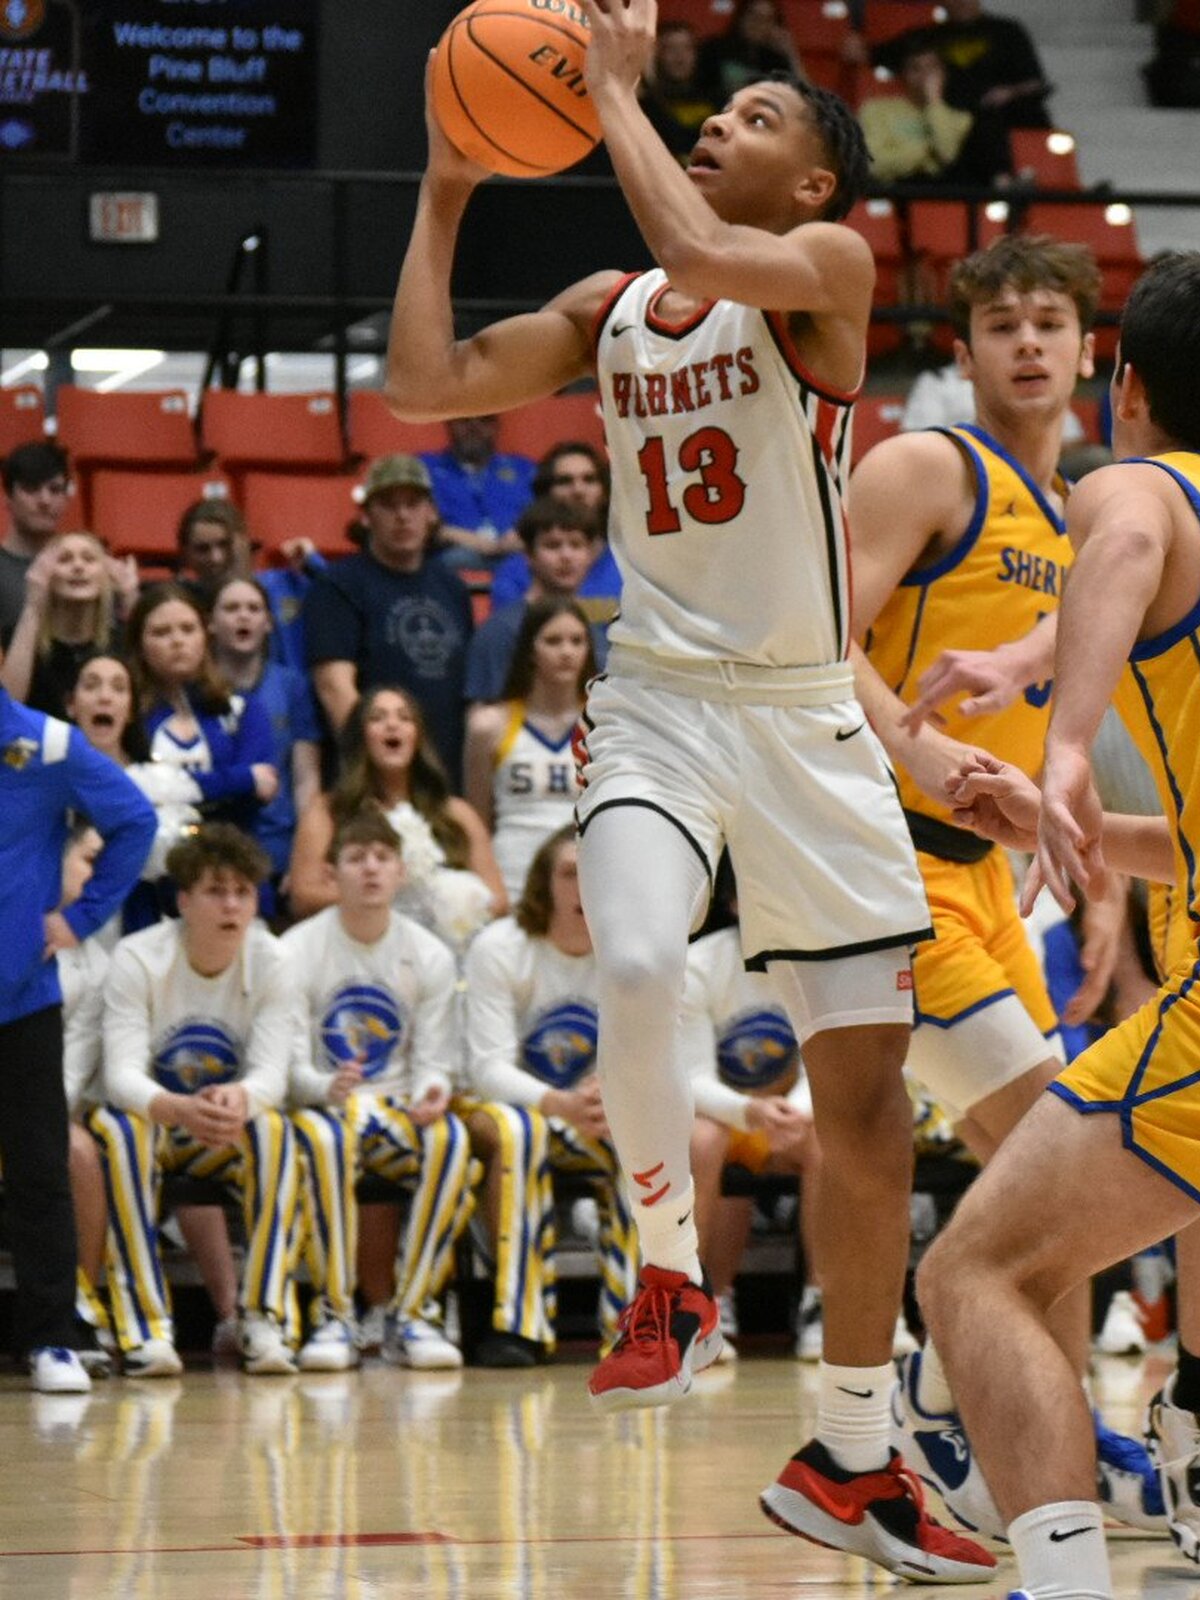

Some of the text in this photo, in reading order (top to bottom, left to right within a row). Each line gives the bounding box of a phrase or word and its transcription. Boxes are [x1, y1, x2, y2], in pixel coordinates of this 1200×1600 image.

[114, 22, 304, 51] Welcome to the
[149, 54, 267, 83] Pine Bluff
[138, 87, 277, 116] Convention
[166, 121, 247, 148] Center
[627, 425, 748, 536] 13
